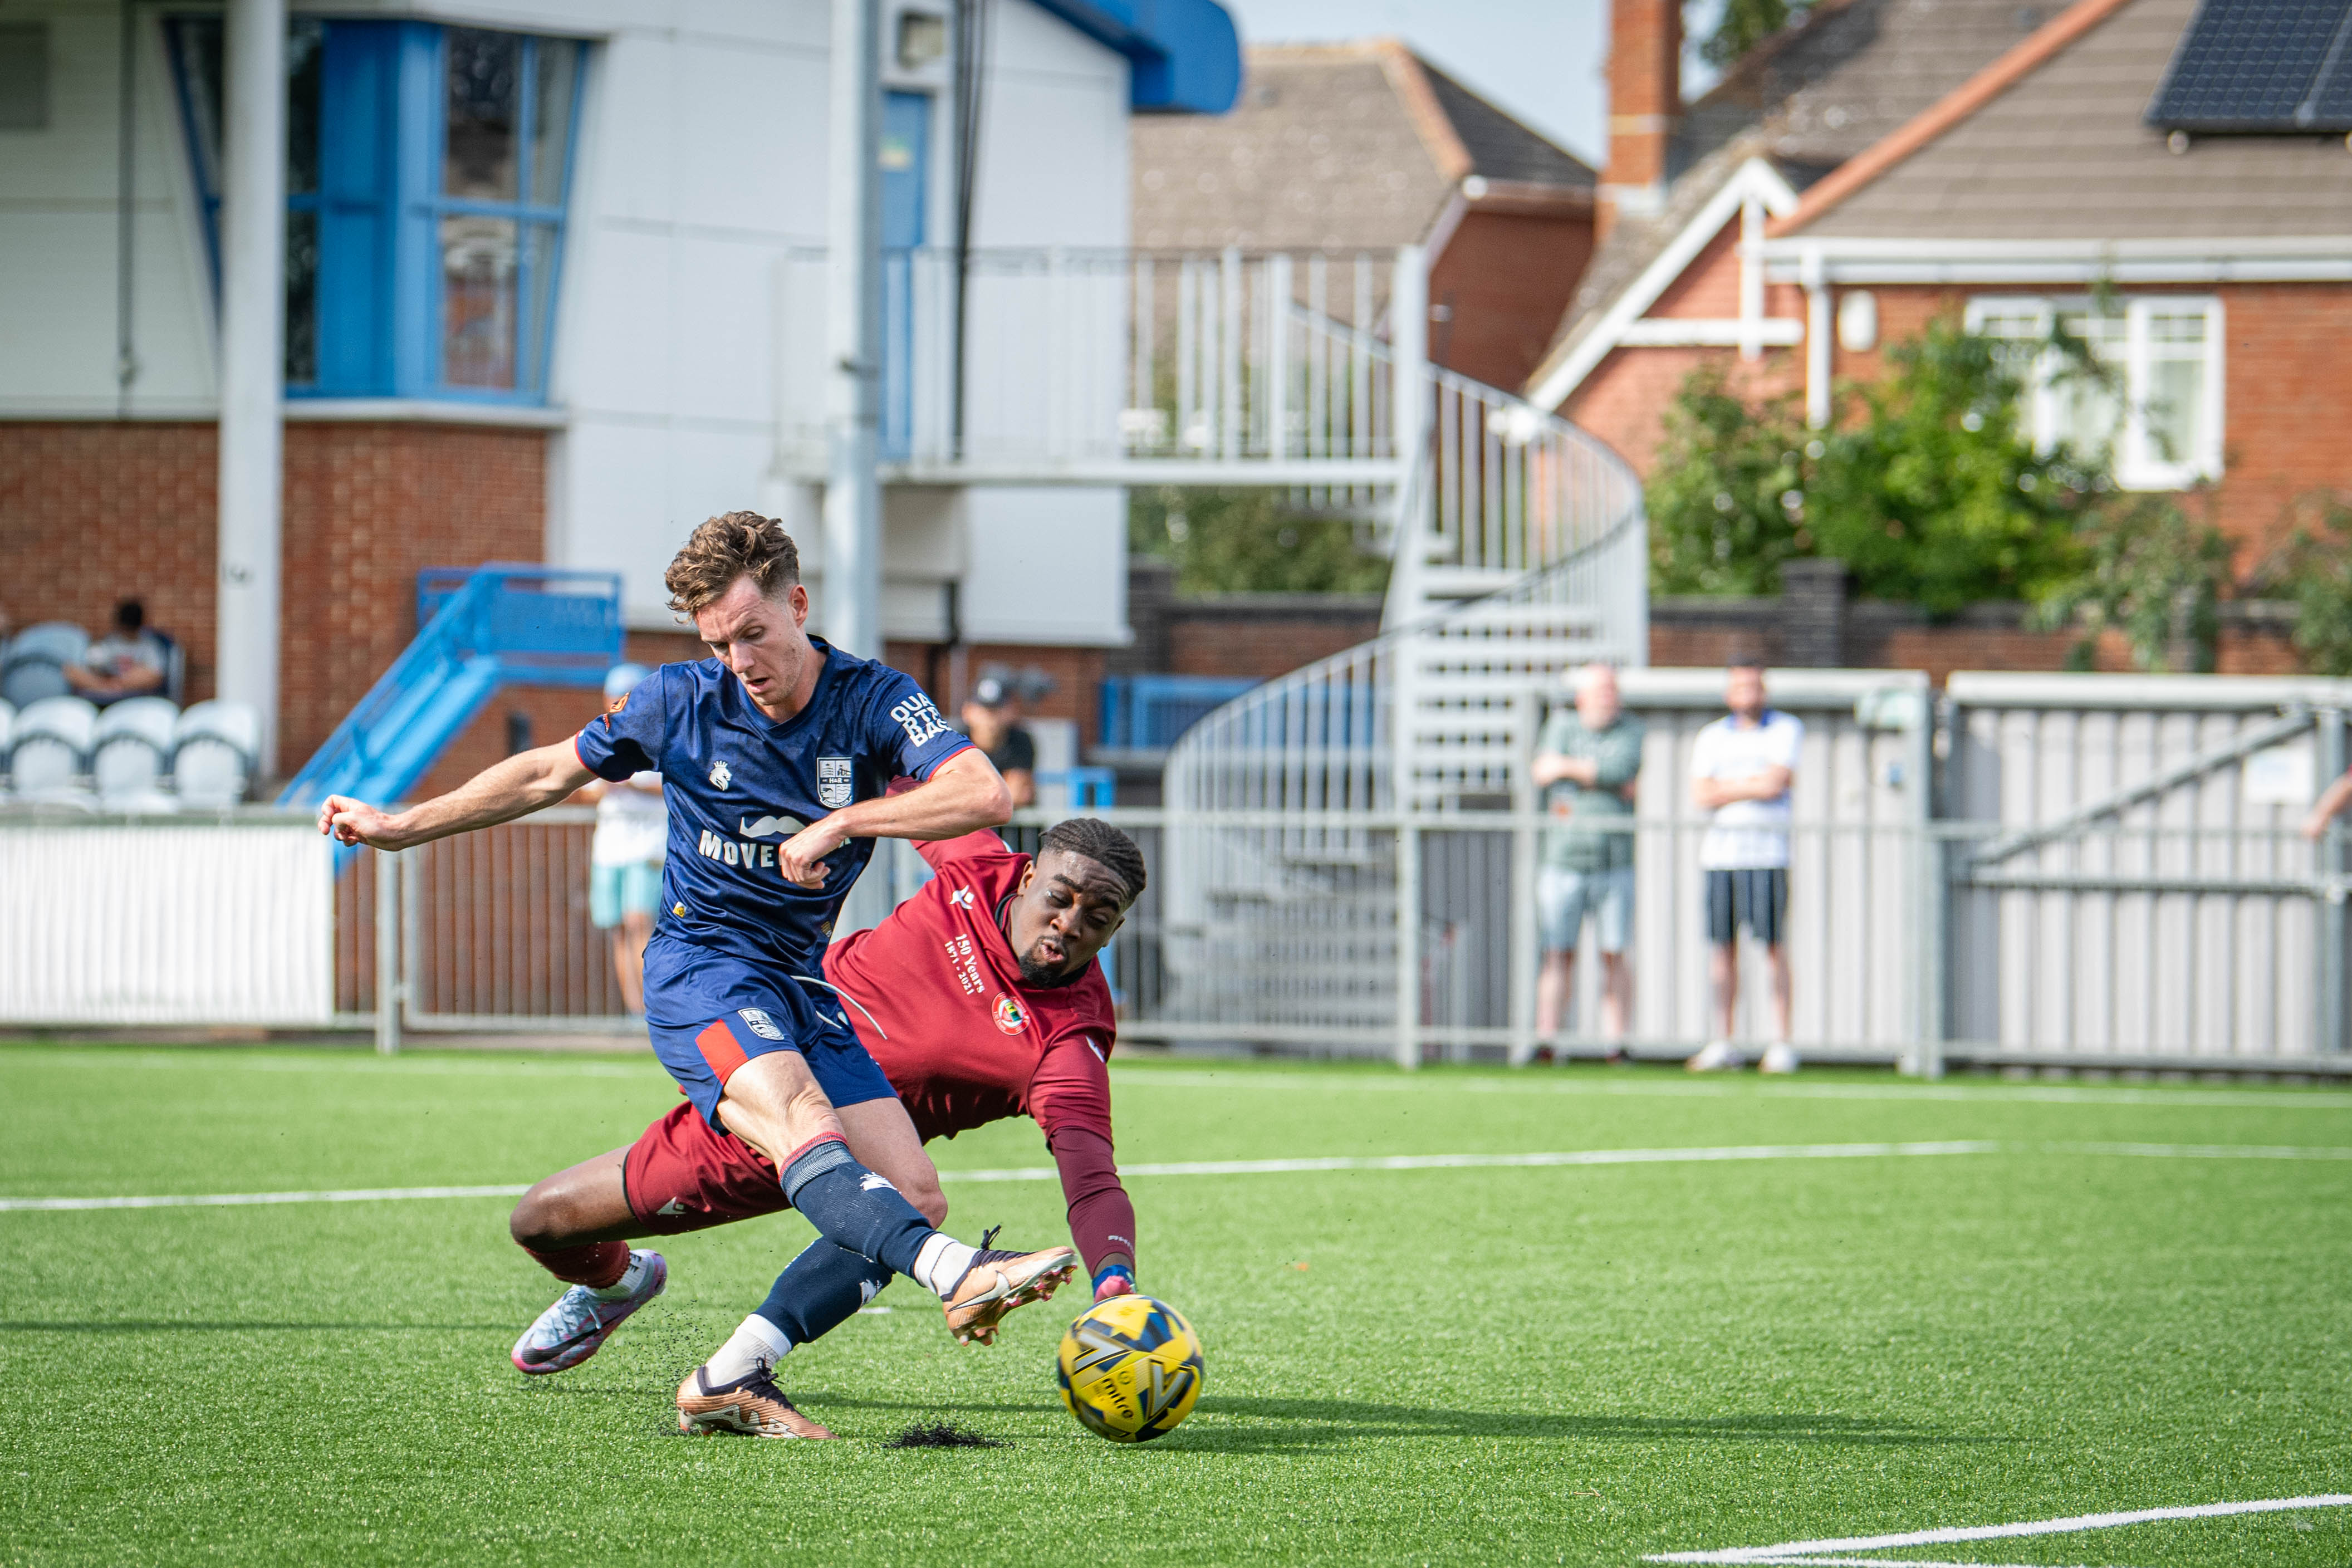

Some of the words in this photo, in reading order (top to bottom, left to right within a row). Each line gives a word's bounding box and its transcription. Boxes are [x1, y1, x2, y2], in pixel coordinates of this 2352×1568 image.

[909, 718, 953, 747] BAC
[698, 829, 851, 869] MOVE
[944, 940, 959, 964] 1871
[958, 971, 975, 995] 2021
[955, 933, 972, 955] 150
[964, 954, 986, 993] Years
